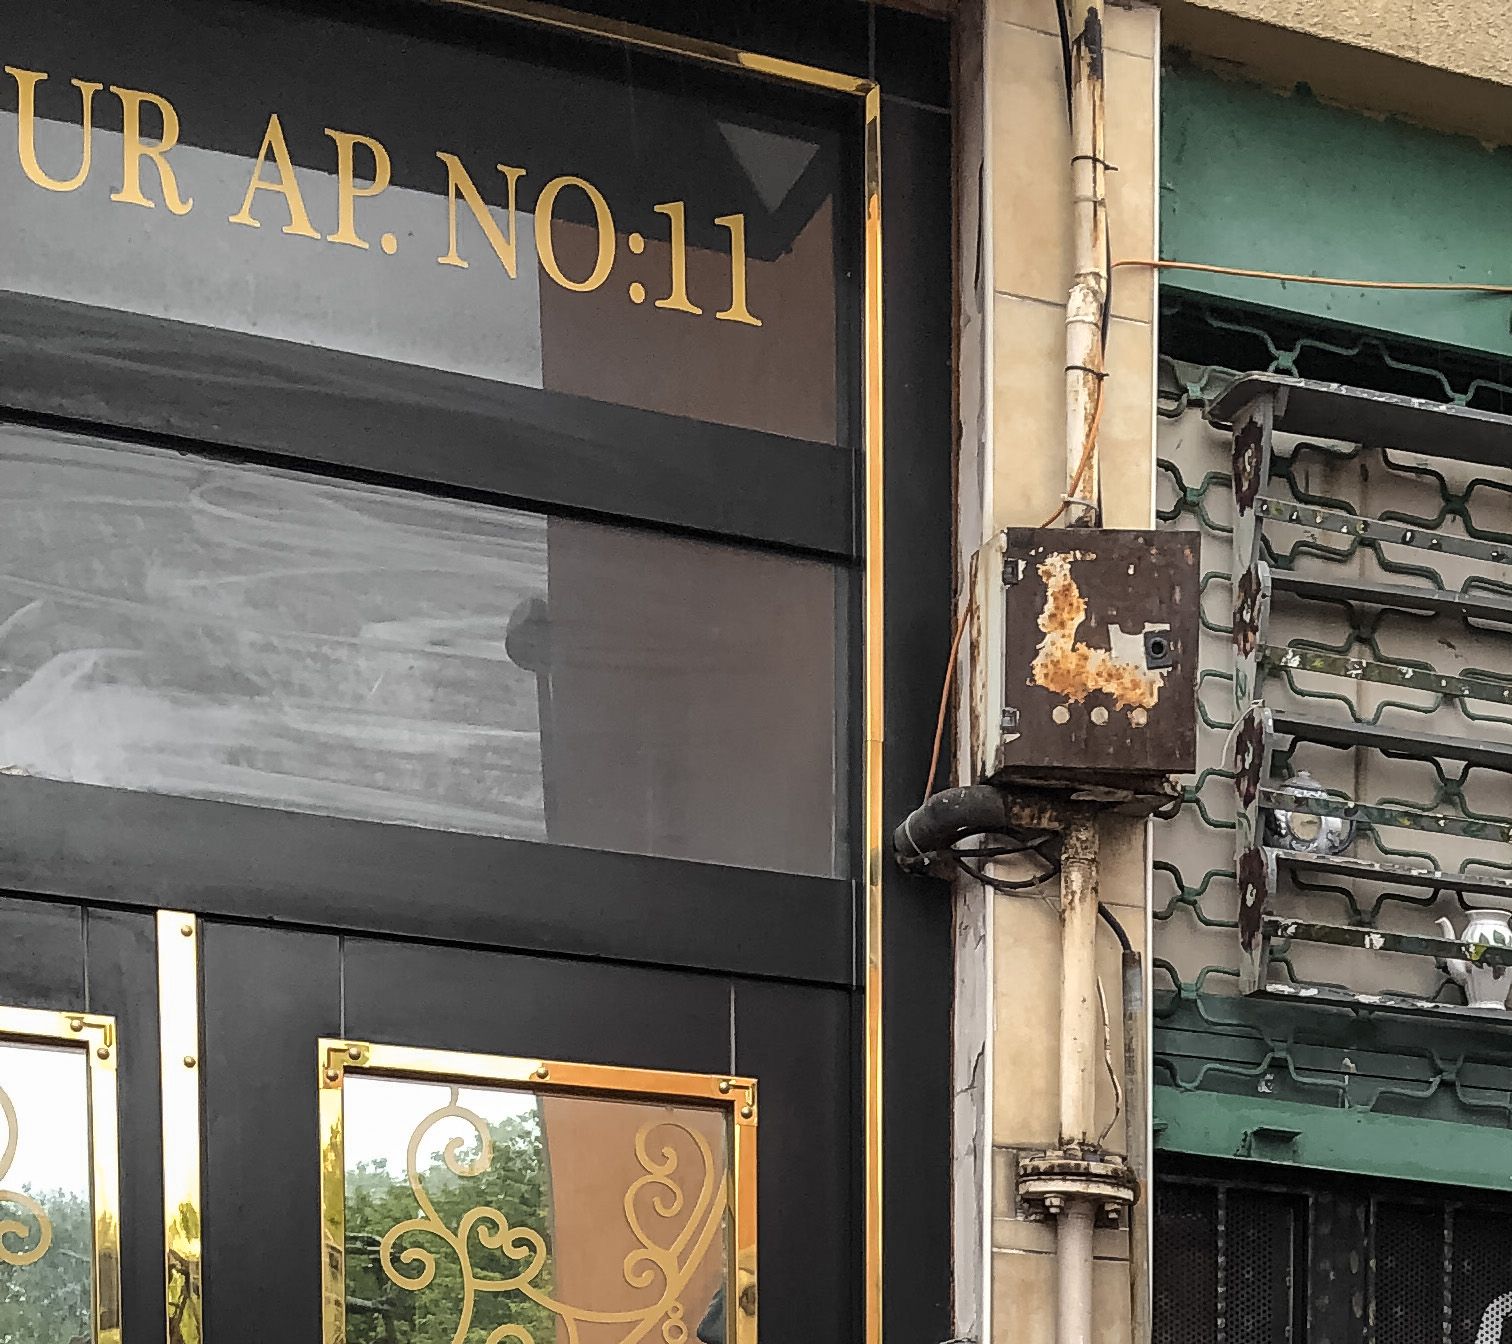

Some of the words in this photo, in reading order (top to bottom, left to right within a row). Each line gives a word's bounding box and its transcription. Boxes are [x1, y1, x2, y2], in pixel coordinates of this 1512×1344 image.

[4, 65, 194, 217] UR
[227, 113, 399, 256] AP.
[436, 150, 763, 328] NO:11
